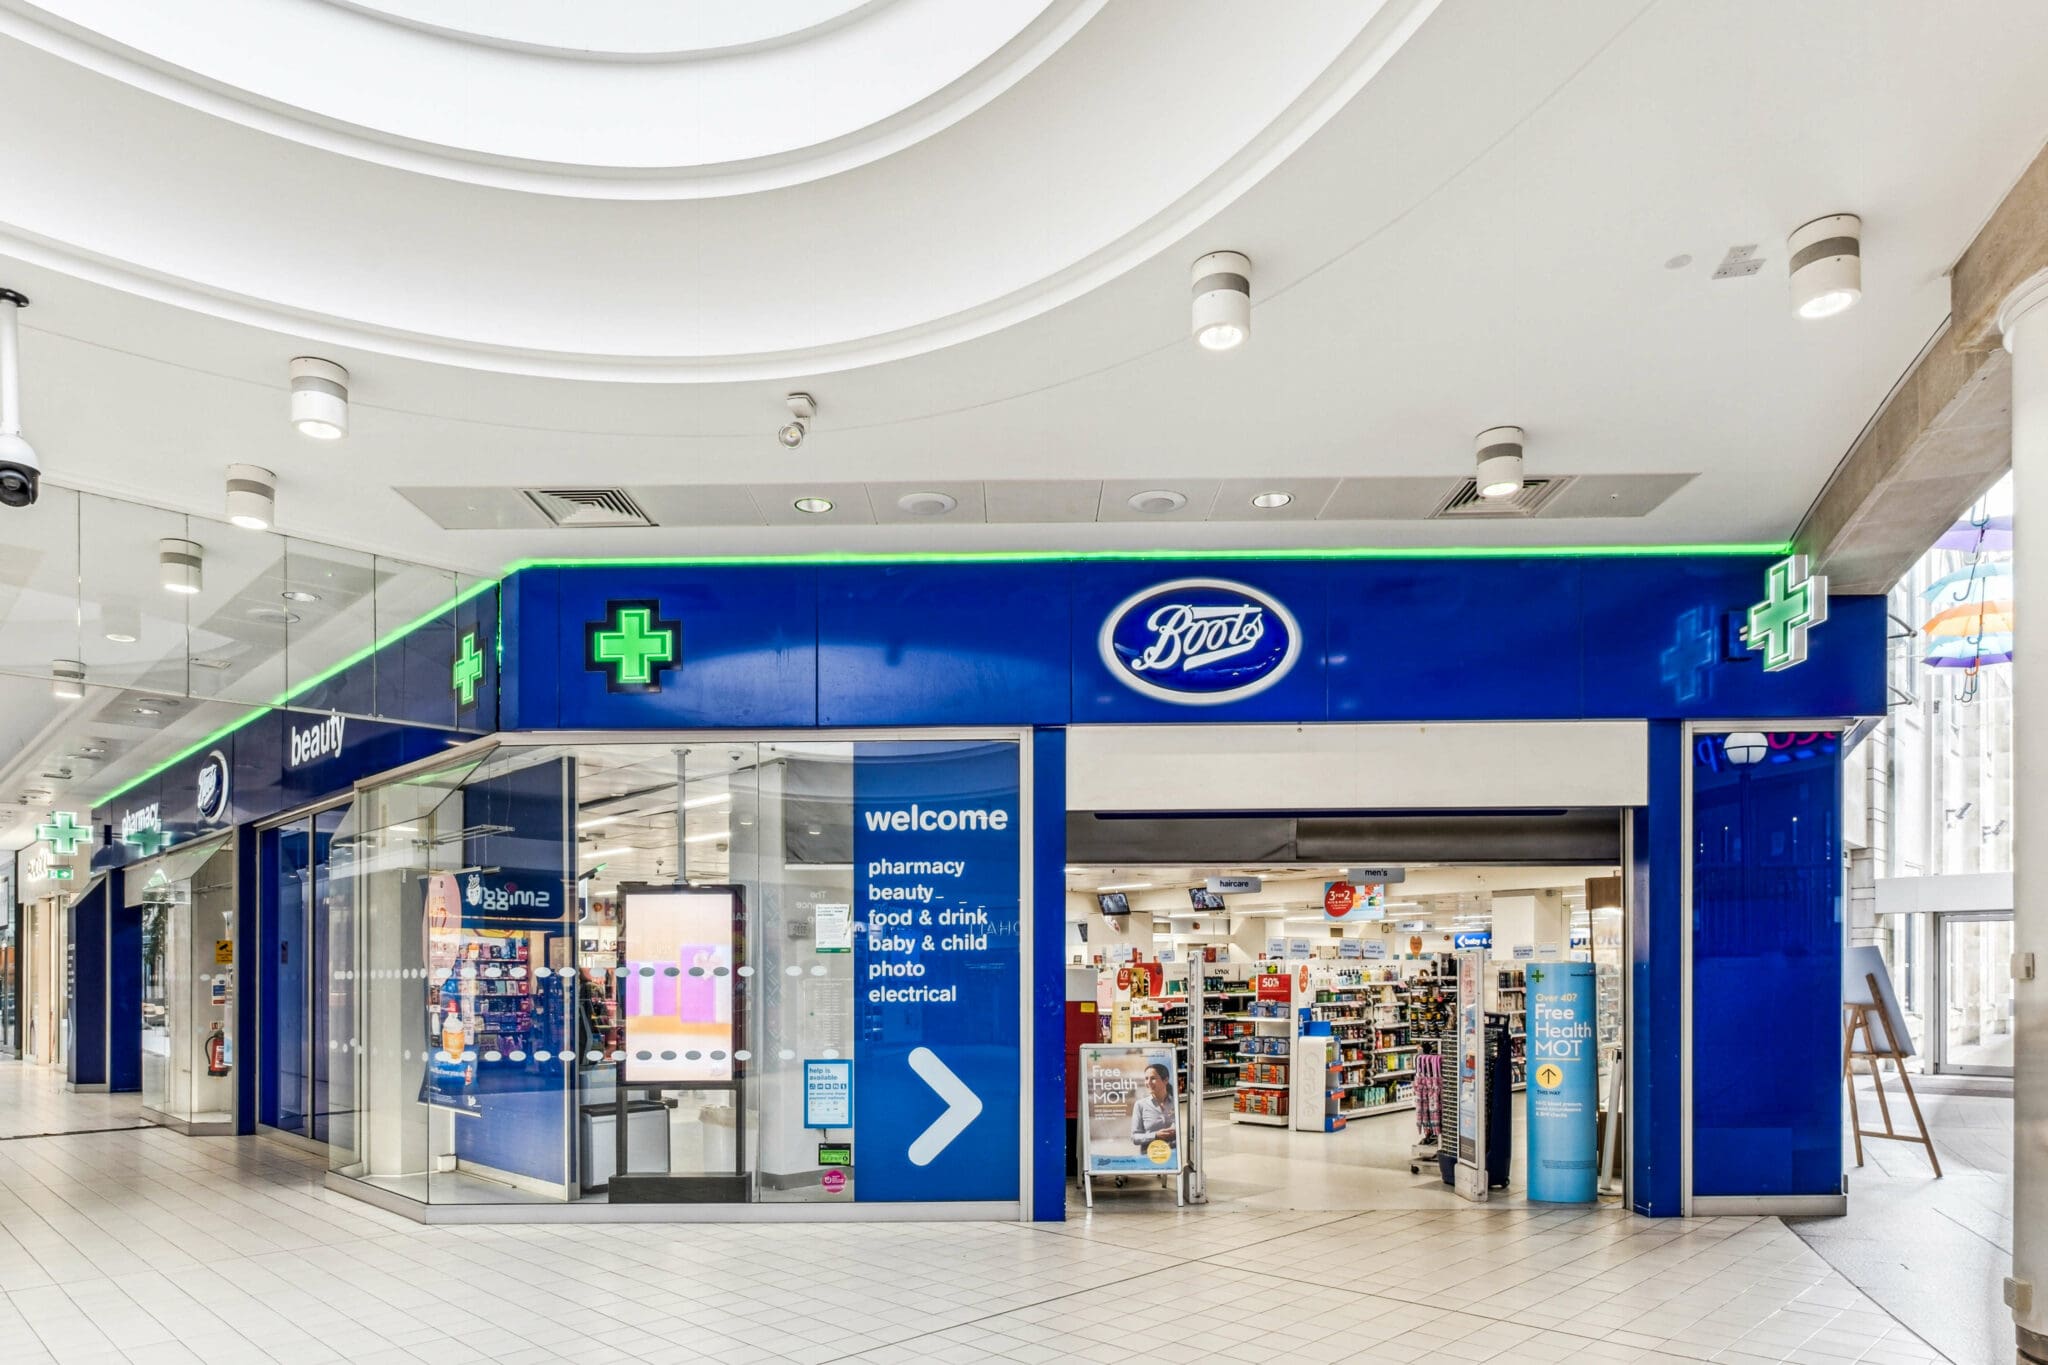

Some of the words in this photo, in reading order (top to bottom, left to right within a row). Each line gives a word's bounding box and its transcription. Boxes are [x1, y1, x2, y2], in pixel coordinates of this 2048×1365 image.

[1131, 603, 1264, 672] Boots
[291, 708, 345, 767] beauty
[865, 803, 1009, 831] welcome
[868, 858, 965, 878] pharmacy
[1364, 868, 1388, 877] men's
[1219, 879, 1249, 888] haircare
[868, 883, 934, 903] beauty
[868, 909, 912, 926] food
[918, 909, 933, 926] &
[938, 908, 988, 925] drink
[868, 934, 916, 955] baby
[921, 934, 935, 951] &
[941, 933, 988, 951] child
[868, 960, 925, 980] photo
[868, 985, 957, 1002] electrical
[1535, 993, 1558, 1002] Over
[1535, 1003, 1574, 1020] Free
[1535, 1021, 1592, 1038] Health
[1535, 1039, 1582, 1056] MOT
[1092, 1065, 1121, 1077] Free
[1092, 1078, 1138, 1091] Health
[1093, 1091, 1128, 1104] MOT
